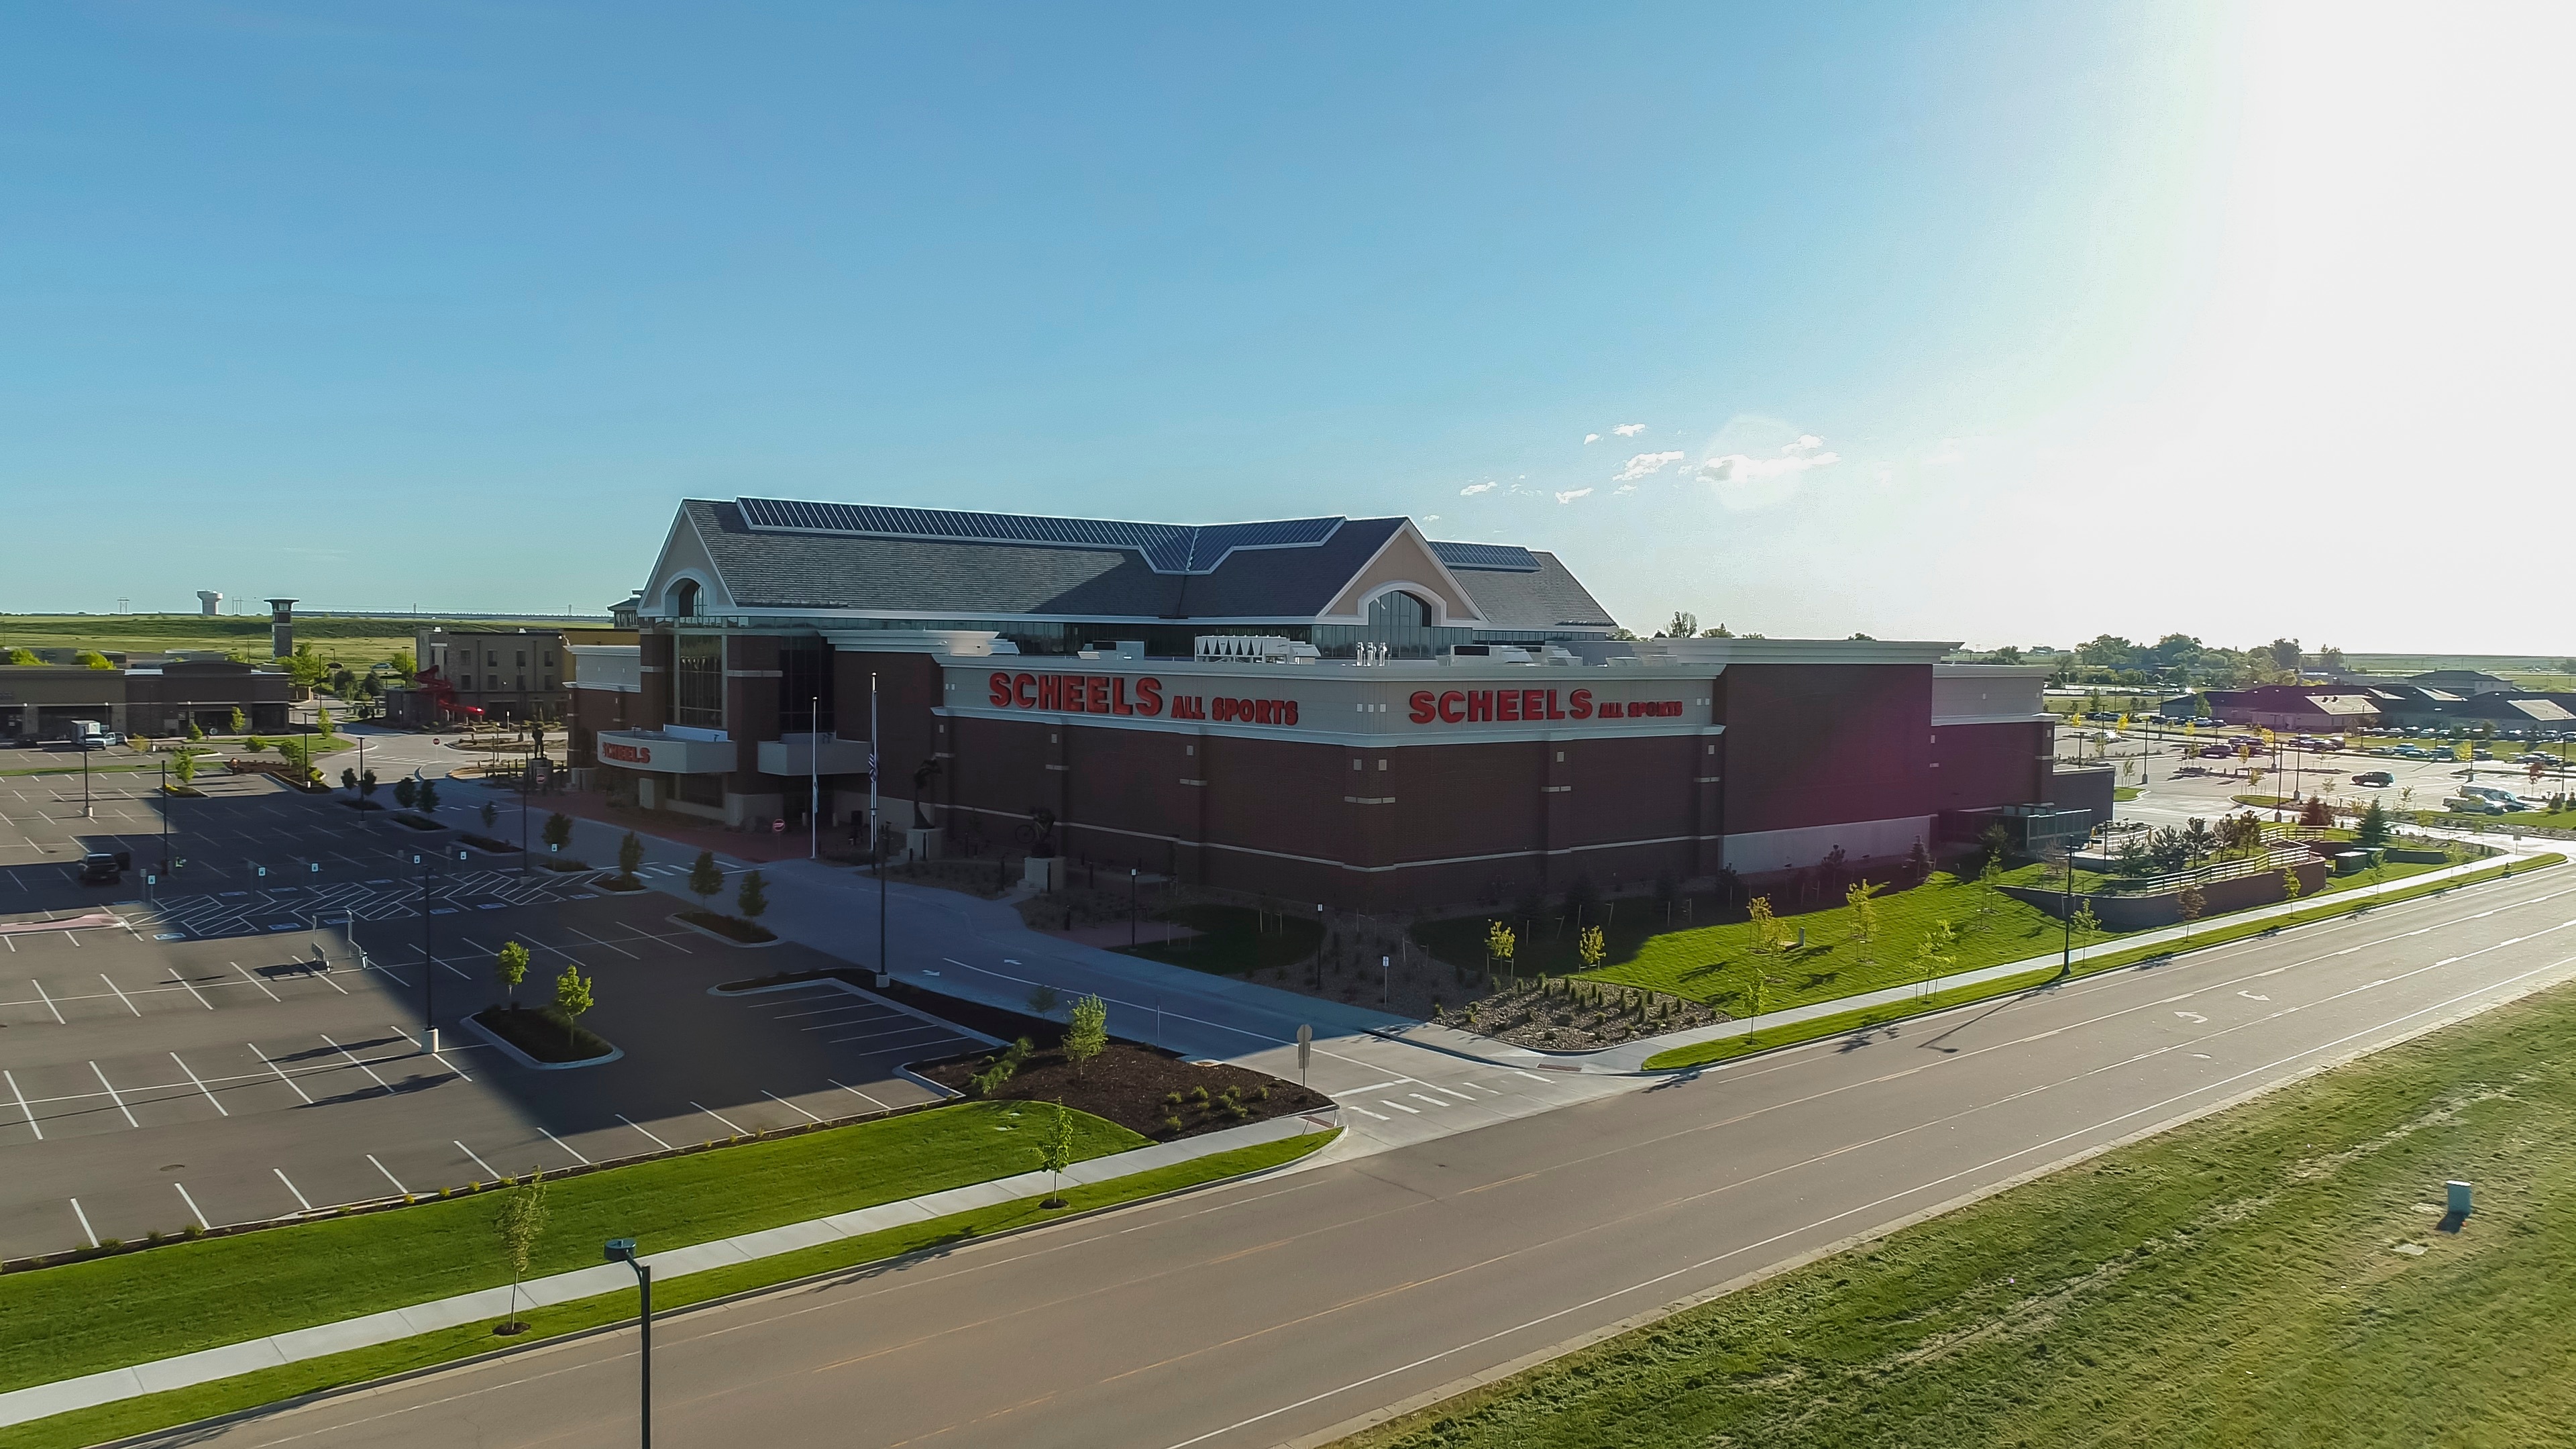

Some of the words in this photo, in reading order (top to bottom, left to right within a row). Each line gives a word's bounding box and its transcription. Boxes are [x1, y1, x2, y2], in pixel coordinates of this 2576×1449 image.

[989, 672, 1163, 716] SCHEELS
[1171, 696, 1205, 720] ALL
[1212, 697, 1299, 726] SPORTS
[1409, 688, 1593, 724] SCHEELS
[1598, 702, 1625, 718] ALL
[1627, 701, 1683, 717] SPORTS
